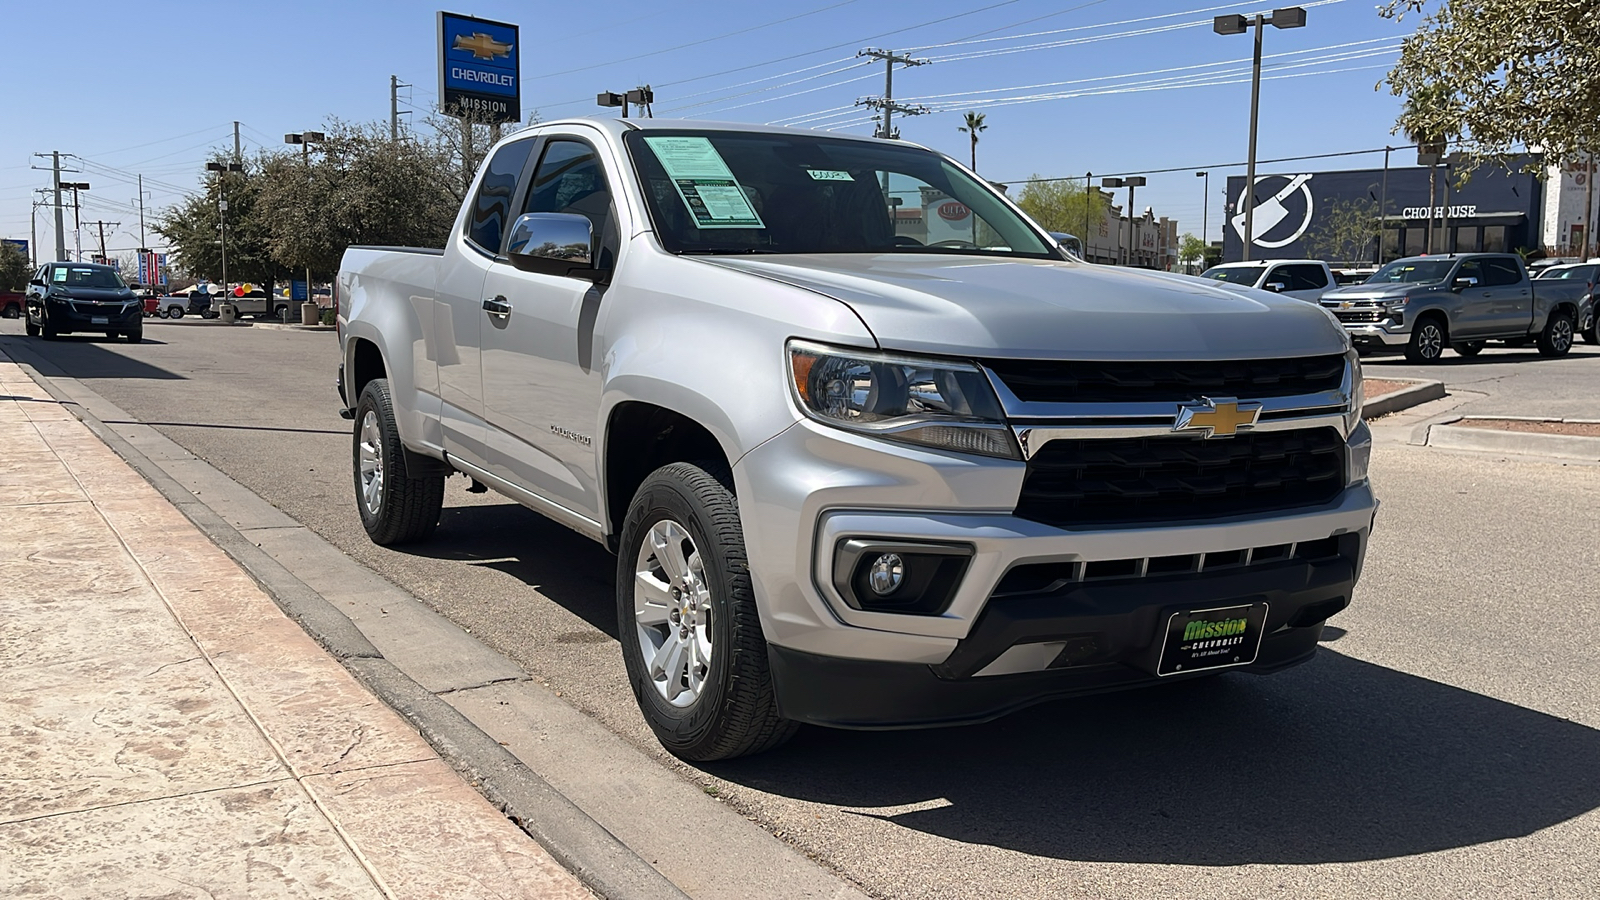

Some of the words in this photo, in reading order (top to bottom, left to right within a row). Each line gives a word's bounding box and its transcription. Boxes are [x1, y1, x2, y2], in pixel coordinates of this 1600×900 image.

[452, 67, 514, 87] CHEVROLET
[460, 96, 507, 113] MISSION
[942, 205, 967, 215] ULTA
[1183, 617, 1247, 641] Mission
[1192, 636, 1244, 650] CHEVROLET
